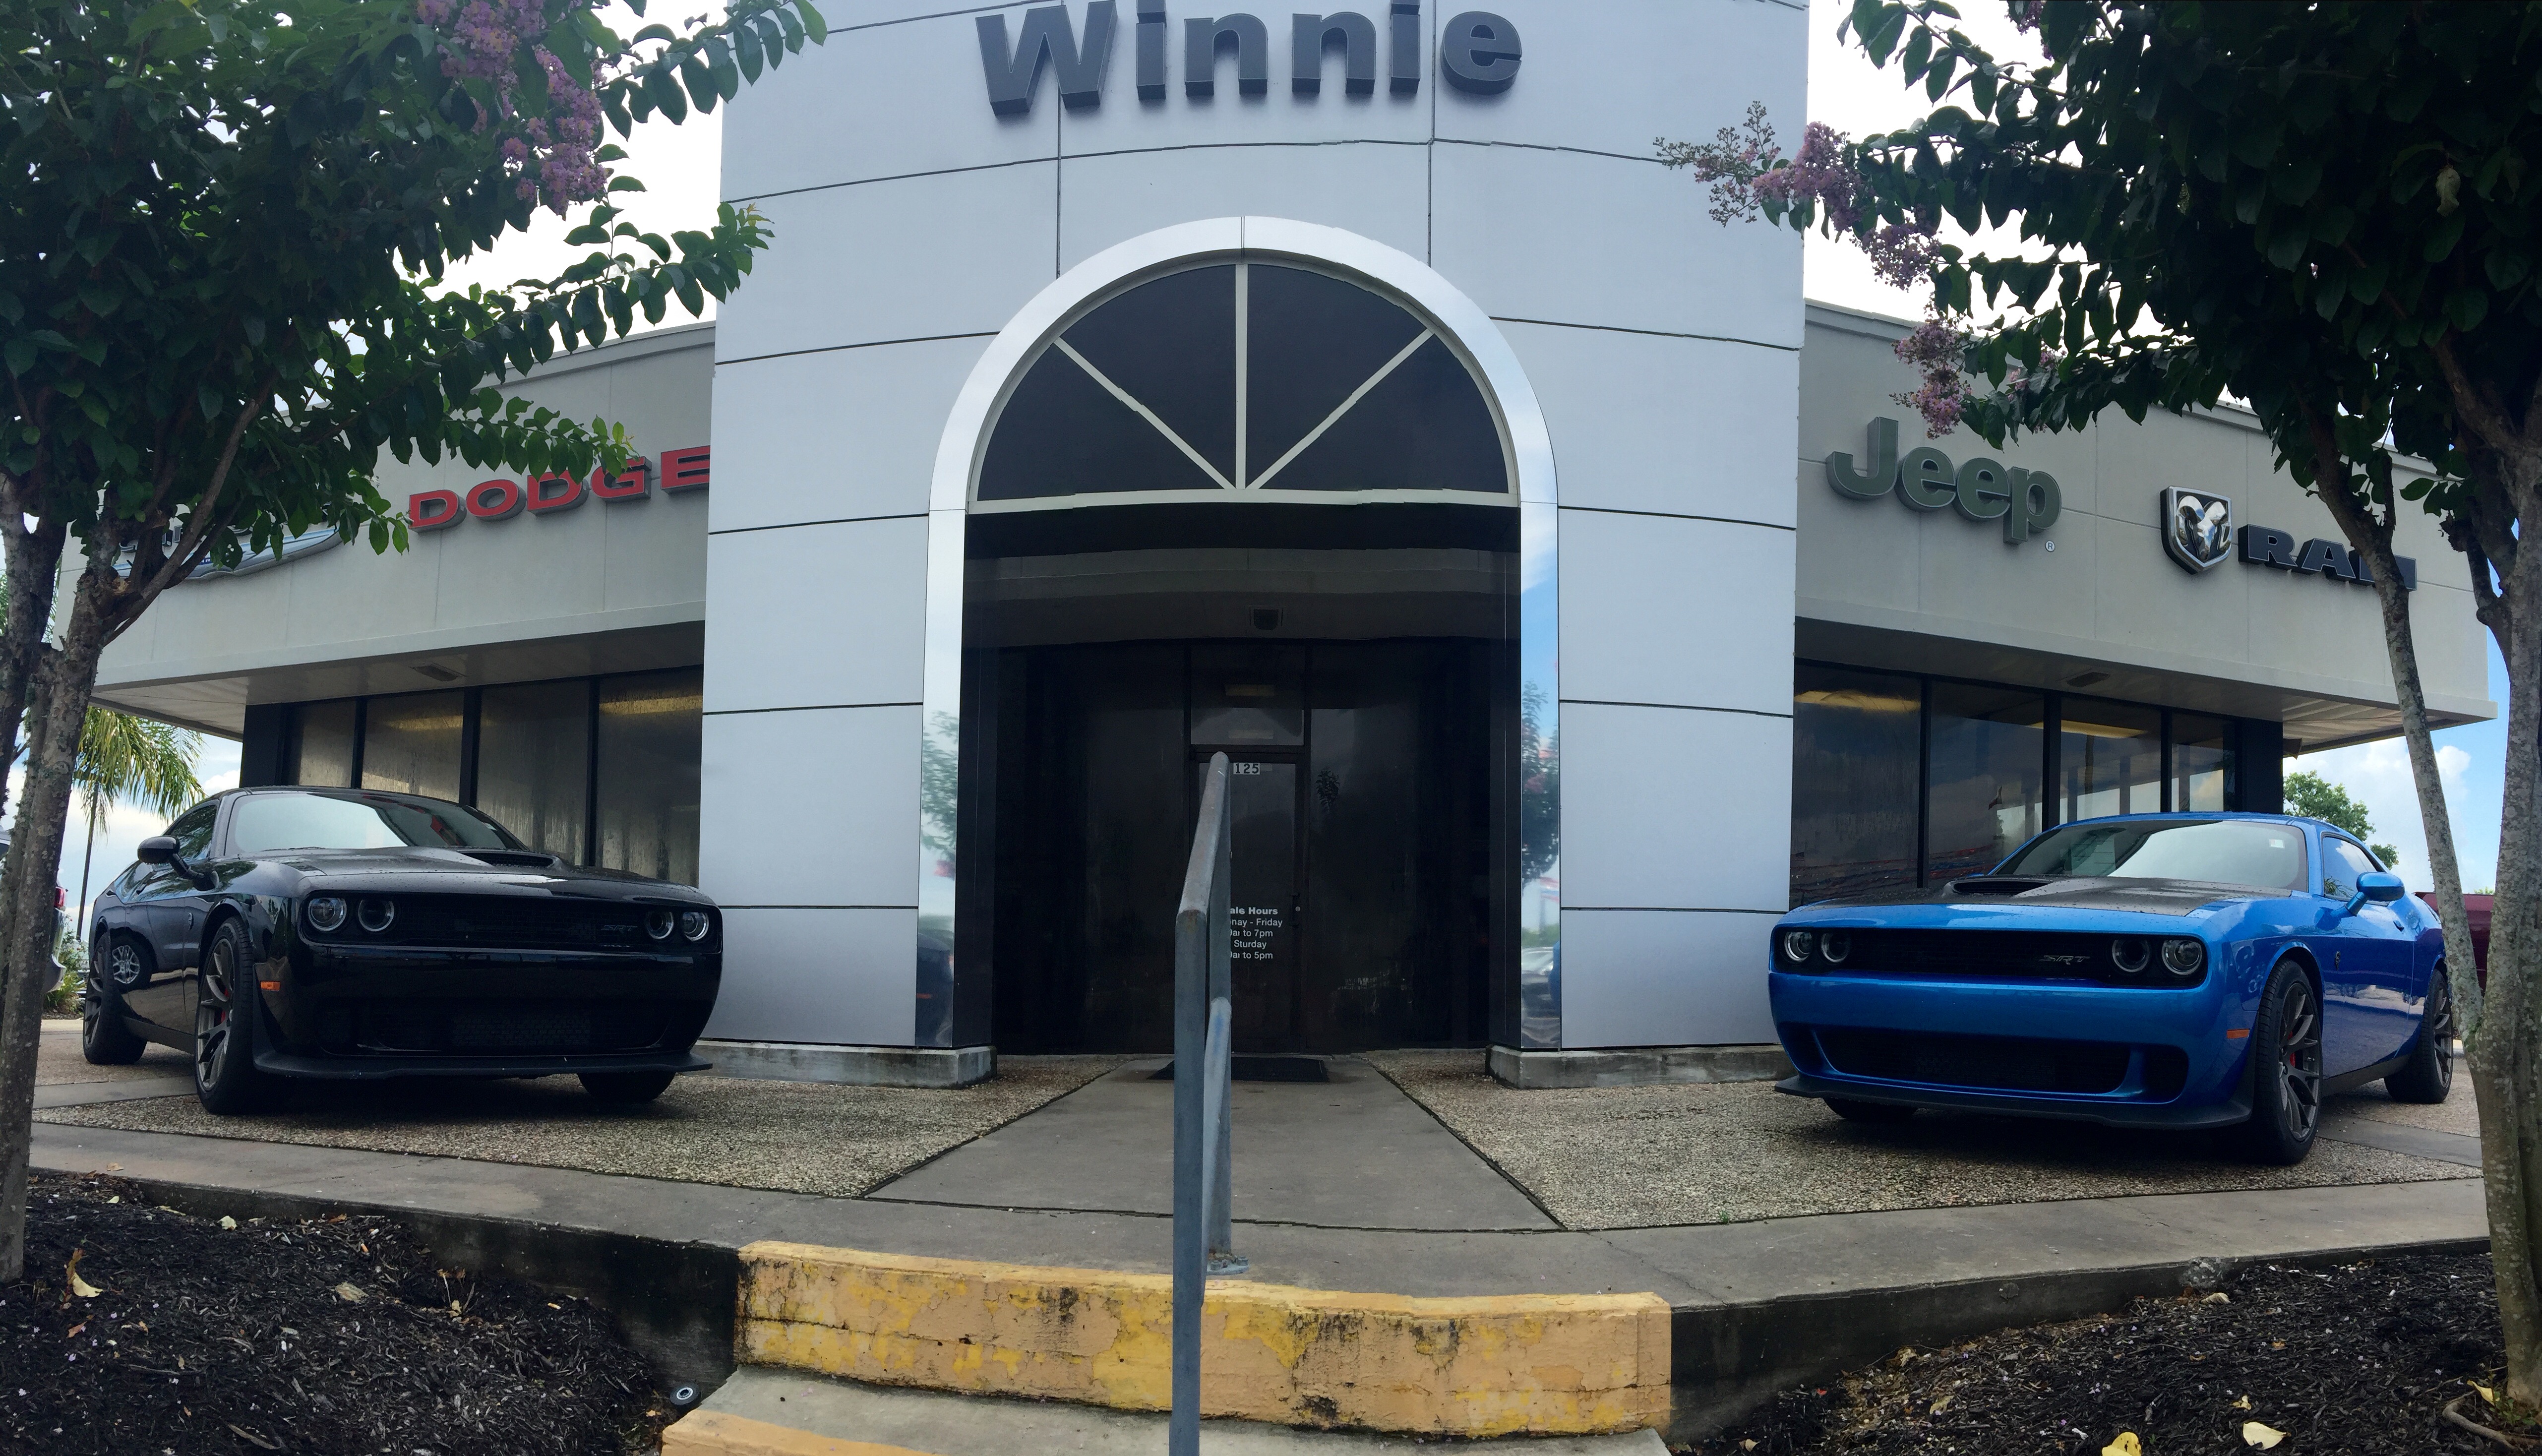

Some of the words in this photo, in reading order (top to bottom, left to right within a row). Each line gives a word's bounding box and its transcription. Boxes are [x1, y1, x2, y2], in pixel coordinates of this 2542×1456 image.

[975, 0, 1523, 114] Winnie
[1826, 417, 2062, 544] Jeep
[409, 445, 711, 531] DODGE
[1235, 763, 1259, 774] 125
[1231, 919, 1247, 927] nay
[1256, 918, 1283, 928] Friday
[601, 924, 638, 934] SRT
[1254, 929, 1273, 938] 7pm
[1234, 939, 1267, 950] Sturday
[1254, 951, 1273, 961] 5pm
[2039, 955, 2091, 965] SRT
